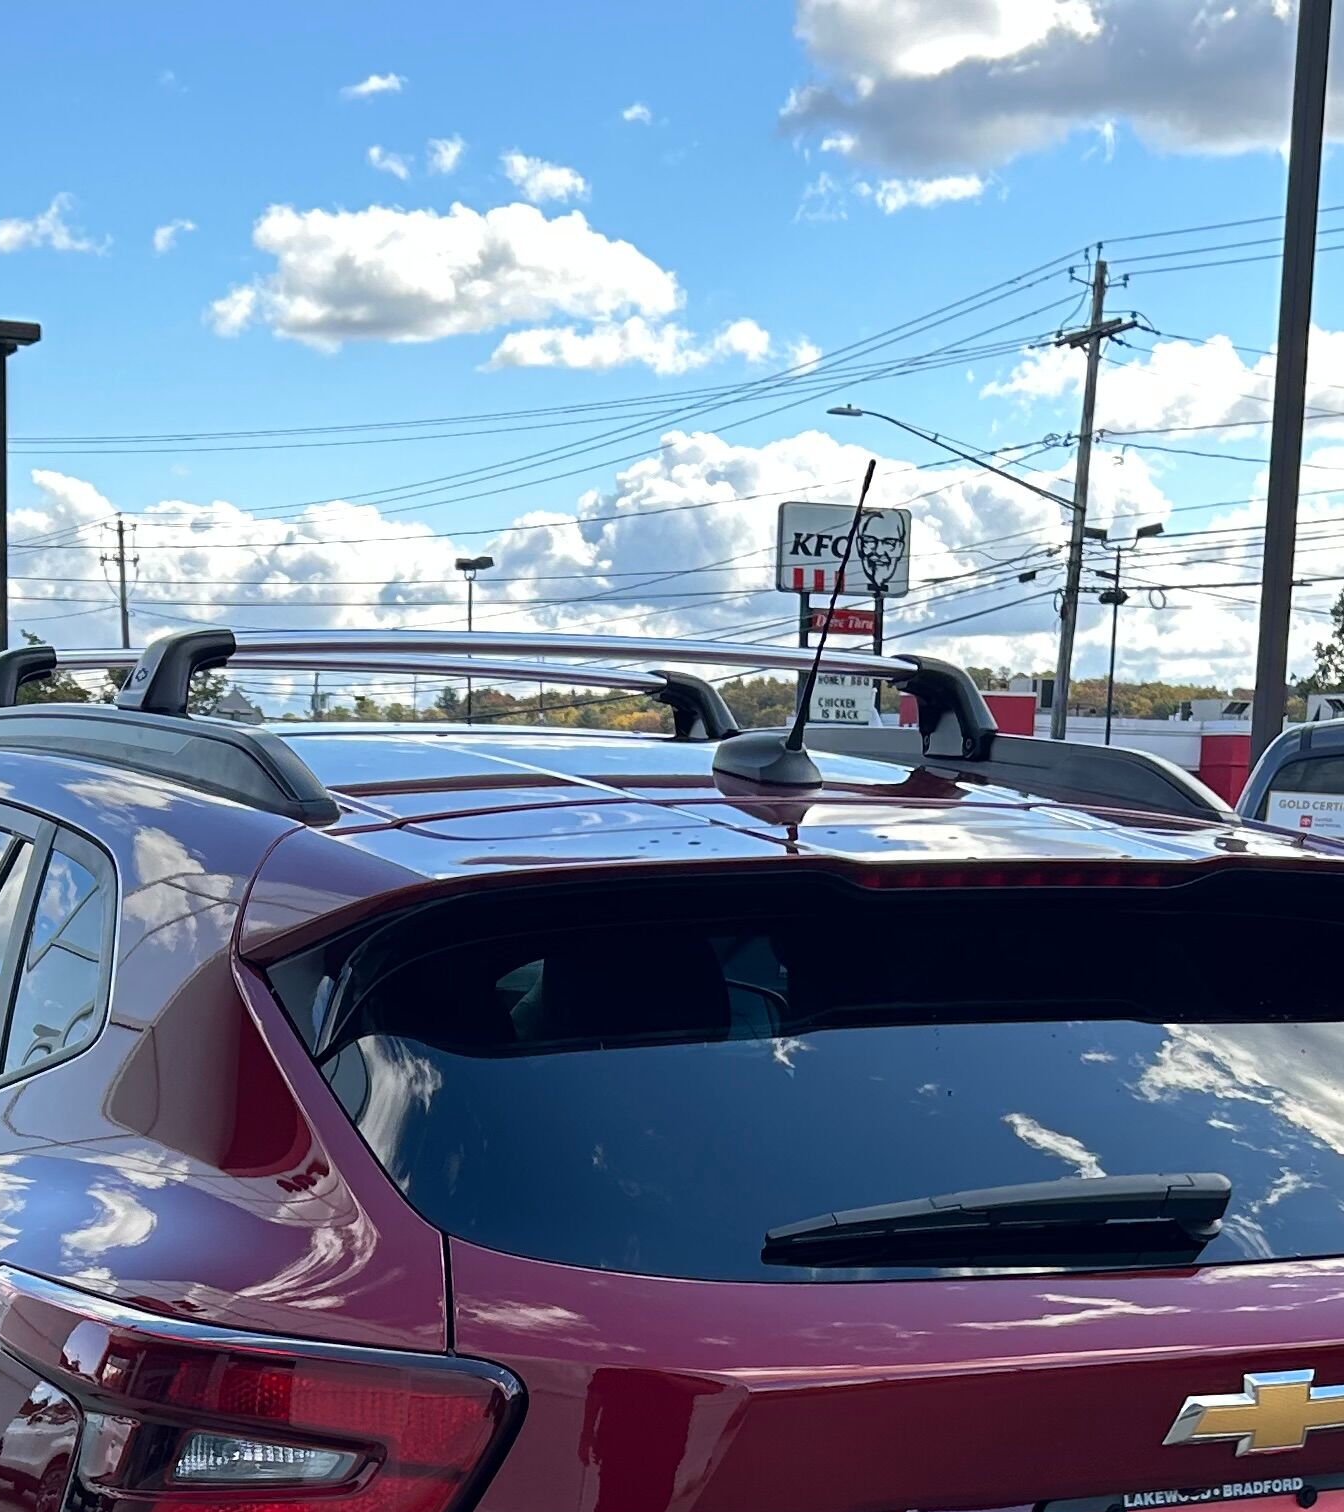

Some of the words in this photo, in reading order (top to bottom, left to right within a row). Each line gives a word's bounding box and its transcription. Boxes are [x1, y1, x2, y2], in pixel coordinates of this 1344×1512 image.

[790, 532, 851, 559] KFC
[848, 615, 874, 630] Thru
[817, 674, 846, 685] HONEY
[850, 675, 870, 686] BBQ
[817, 697, 856, 709] CHICKEN
[821, 708, 830, 719] IS
[835, 709, 859, 720] BACK
[1278, 799, 1311, 810] GOLD
[1123, 1488, 1211, 1508] LAKEWD
[1222, 1477, 1304, 1498] BRADFORD
